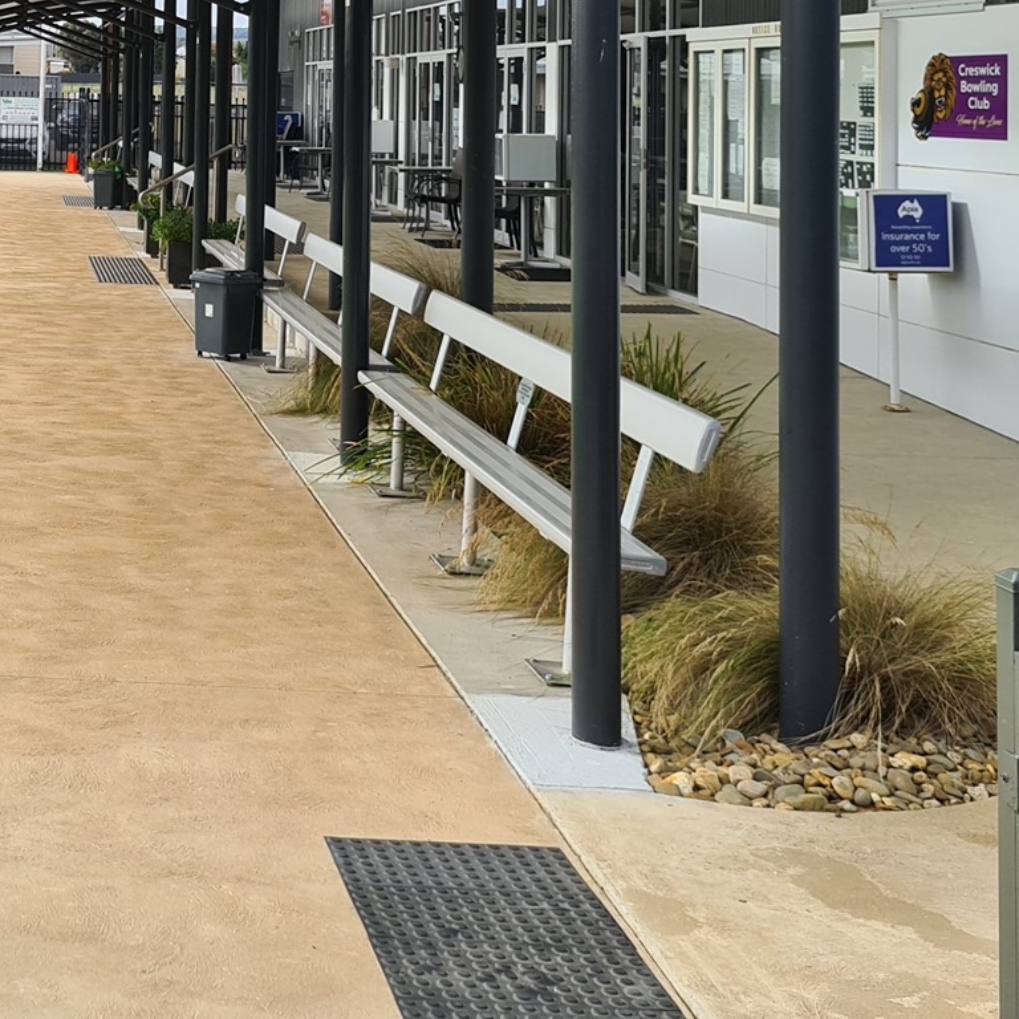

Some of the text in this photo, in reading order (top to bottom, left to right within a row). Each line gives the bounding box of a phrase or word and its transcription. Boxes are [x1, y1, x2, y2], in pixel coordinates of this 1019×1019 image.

[958, 63, 1001, 76] Creswick
[960, 80, 998, 96] Bowling
[968, 97, 990, 109] Club
[881, 231, 940, 241] Insurance for
[890, 243, 933, 253] over 50's
